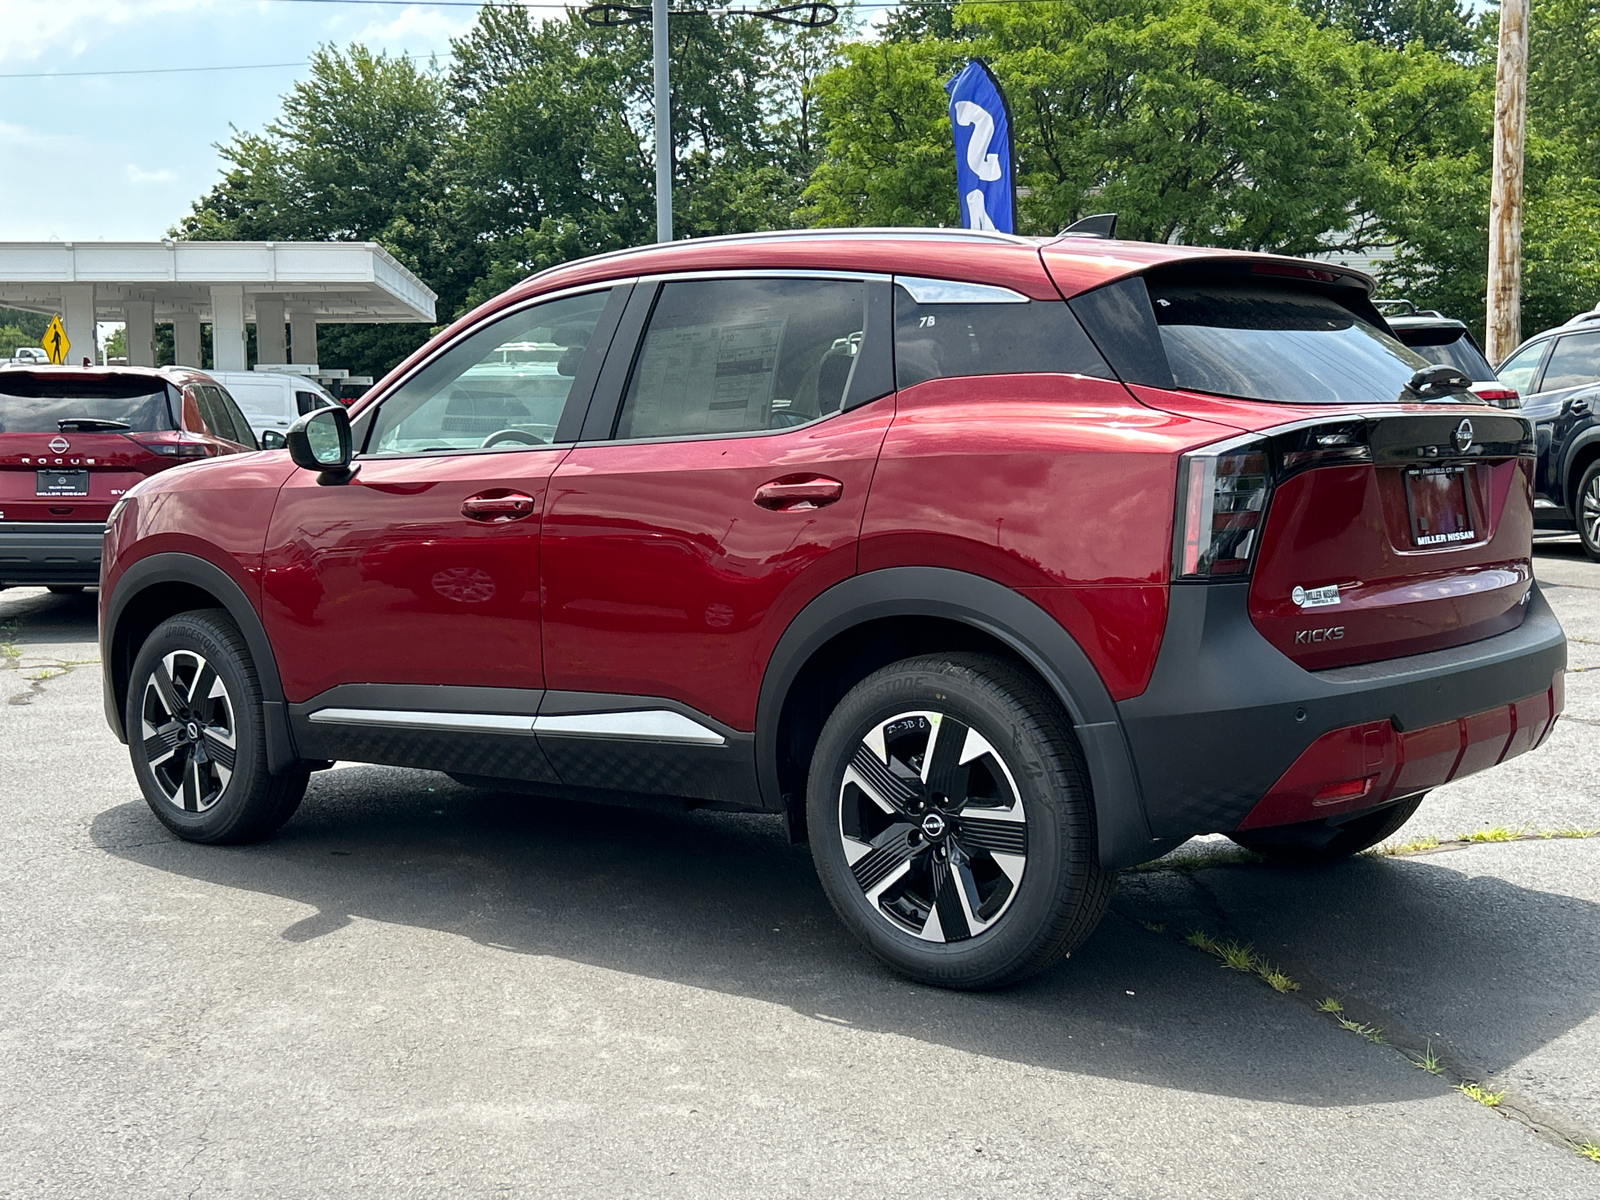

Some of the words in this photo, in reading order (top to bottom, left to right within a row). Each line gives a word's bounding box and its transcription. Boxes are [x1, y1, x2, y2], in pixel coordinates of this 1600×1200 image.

[918, 315, 936, 328] 7B
[1417, 534, 1447, 546] MILLER
[1448, 531, 1475, 542] NISSAN
[1305, 590, 1322, 600] MILLER
[165, 626, 222, 658] BRIDGESTONE
[1294, 626, 1345, 644] KICKS
